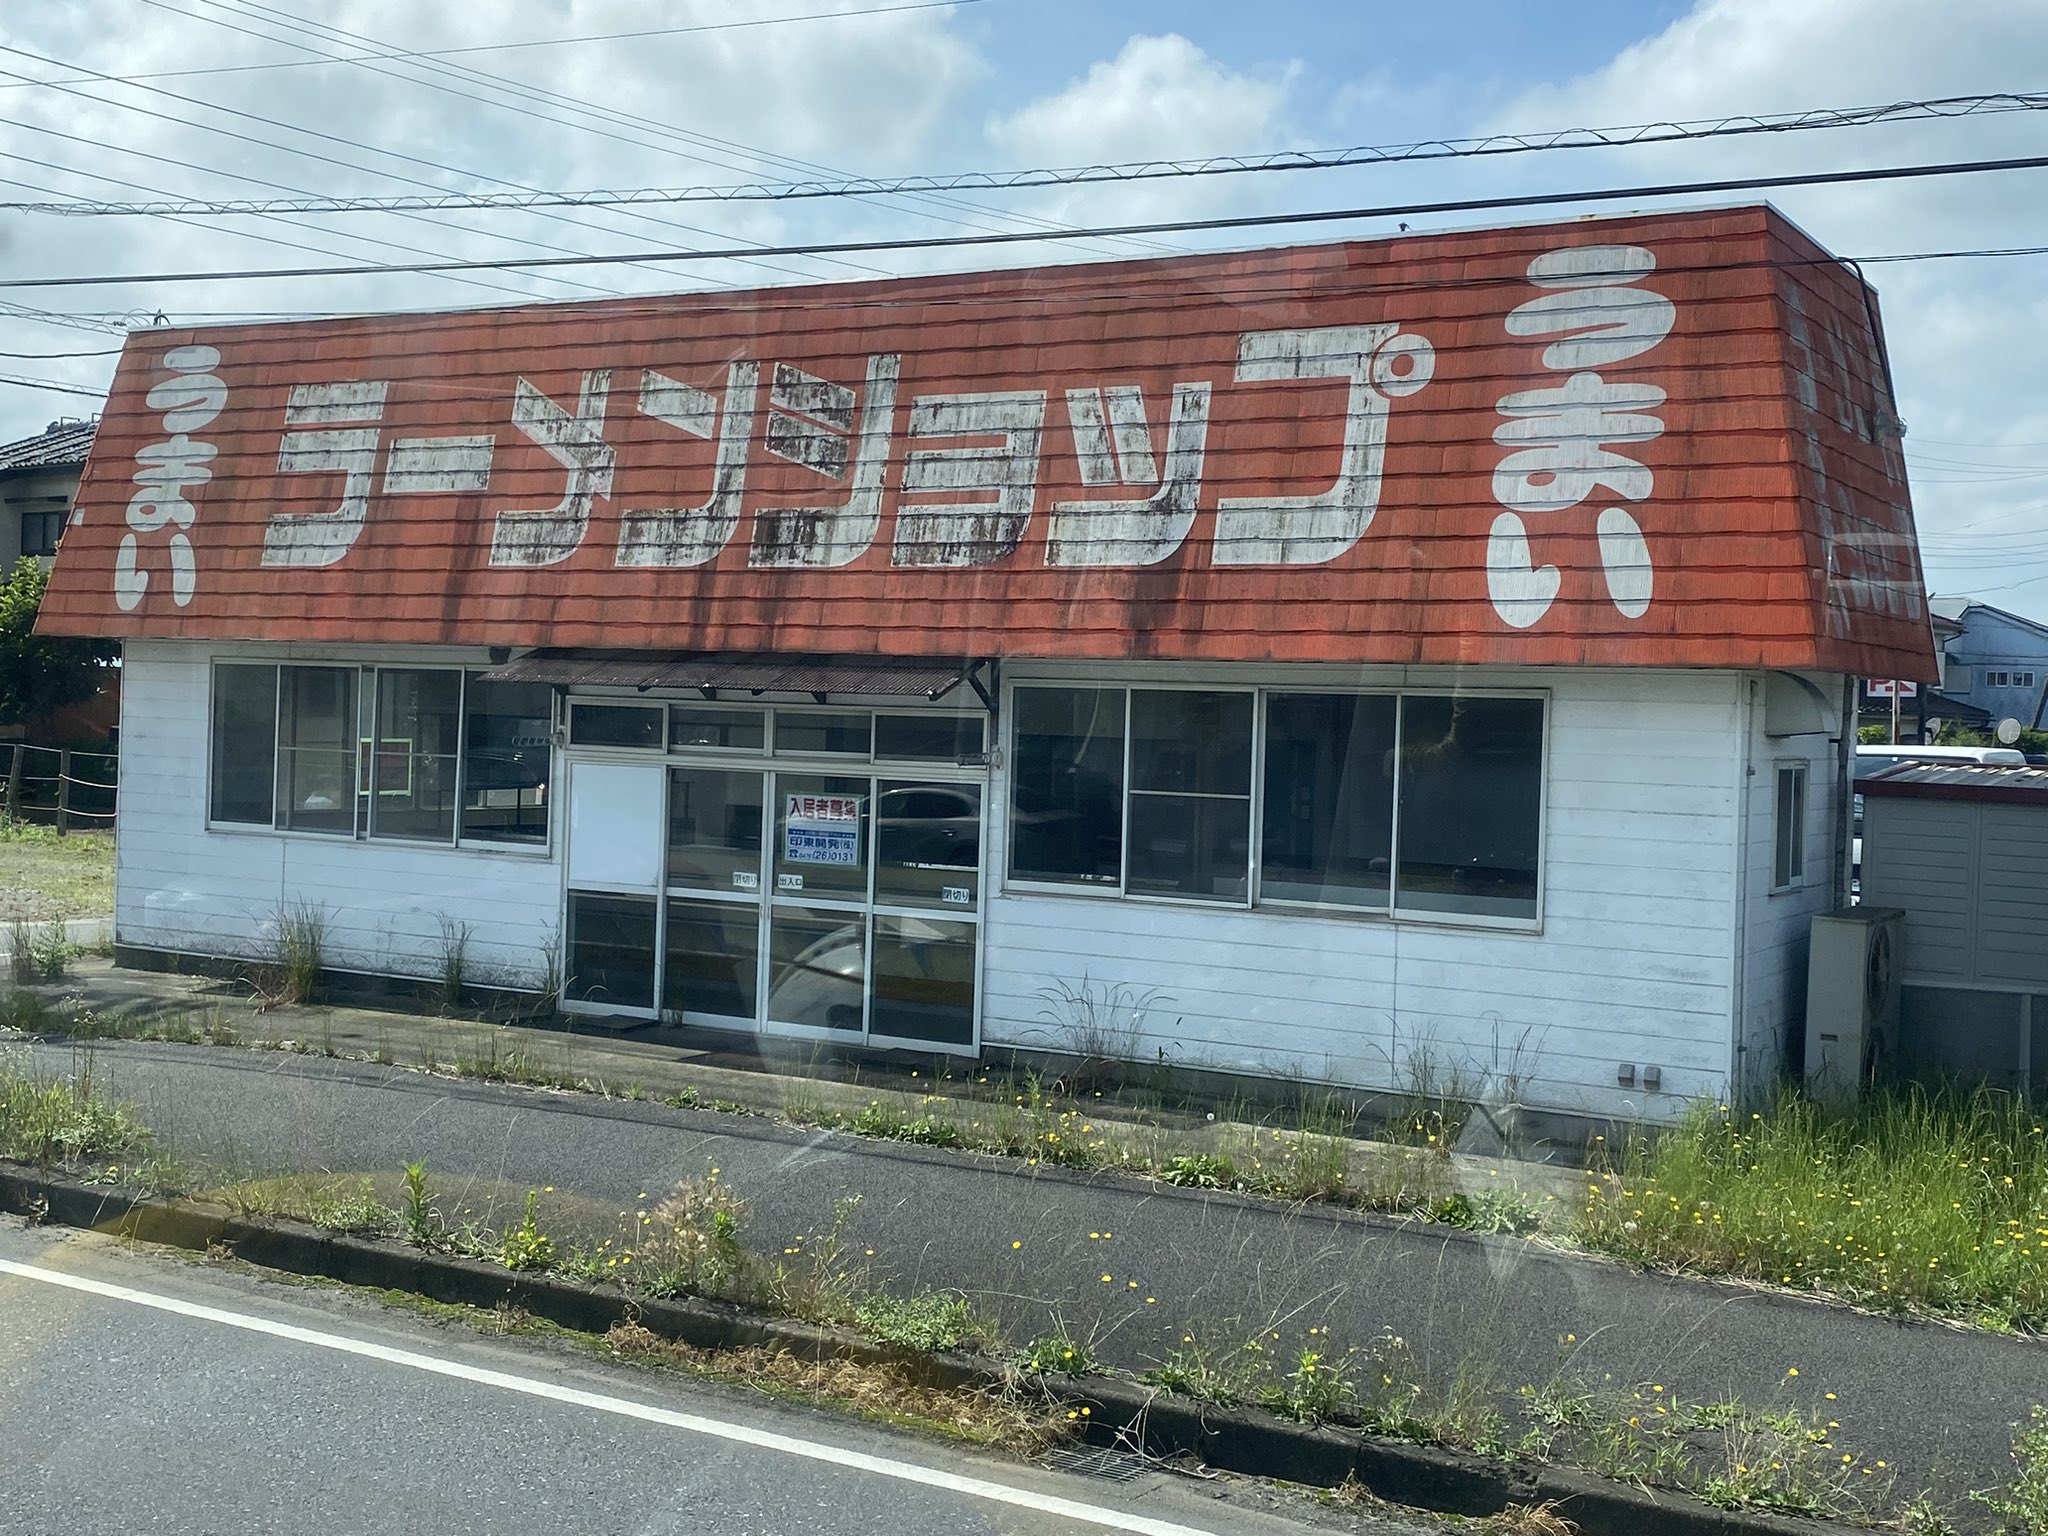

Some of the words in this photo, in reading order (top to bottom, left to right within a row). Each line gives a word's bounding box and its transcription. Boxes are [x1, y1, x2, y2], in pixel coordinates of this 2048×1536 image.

[113, 345, 228, 611] うまい
[260, 322, 1436, 570] ラーメンショップ
[1486, 244, 1677, 629] うまい
[779, 875, 803, 887] 出入口
[789, 797, 857, 821] 入居者募集
